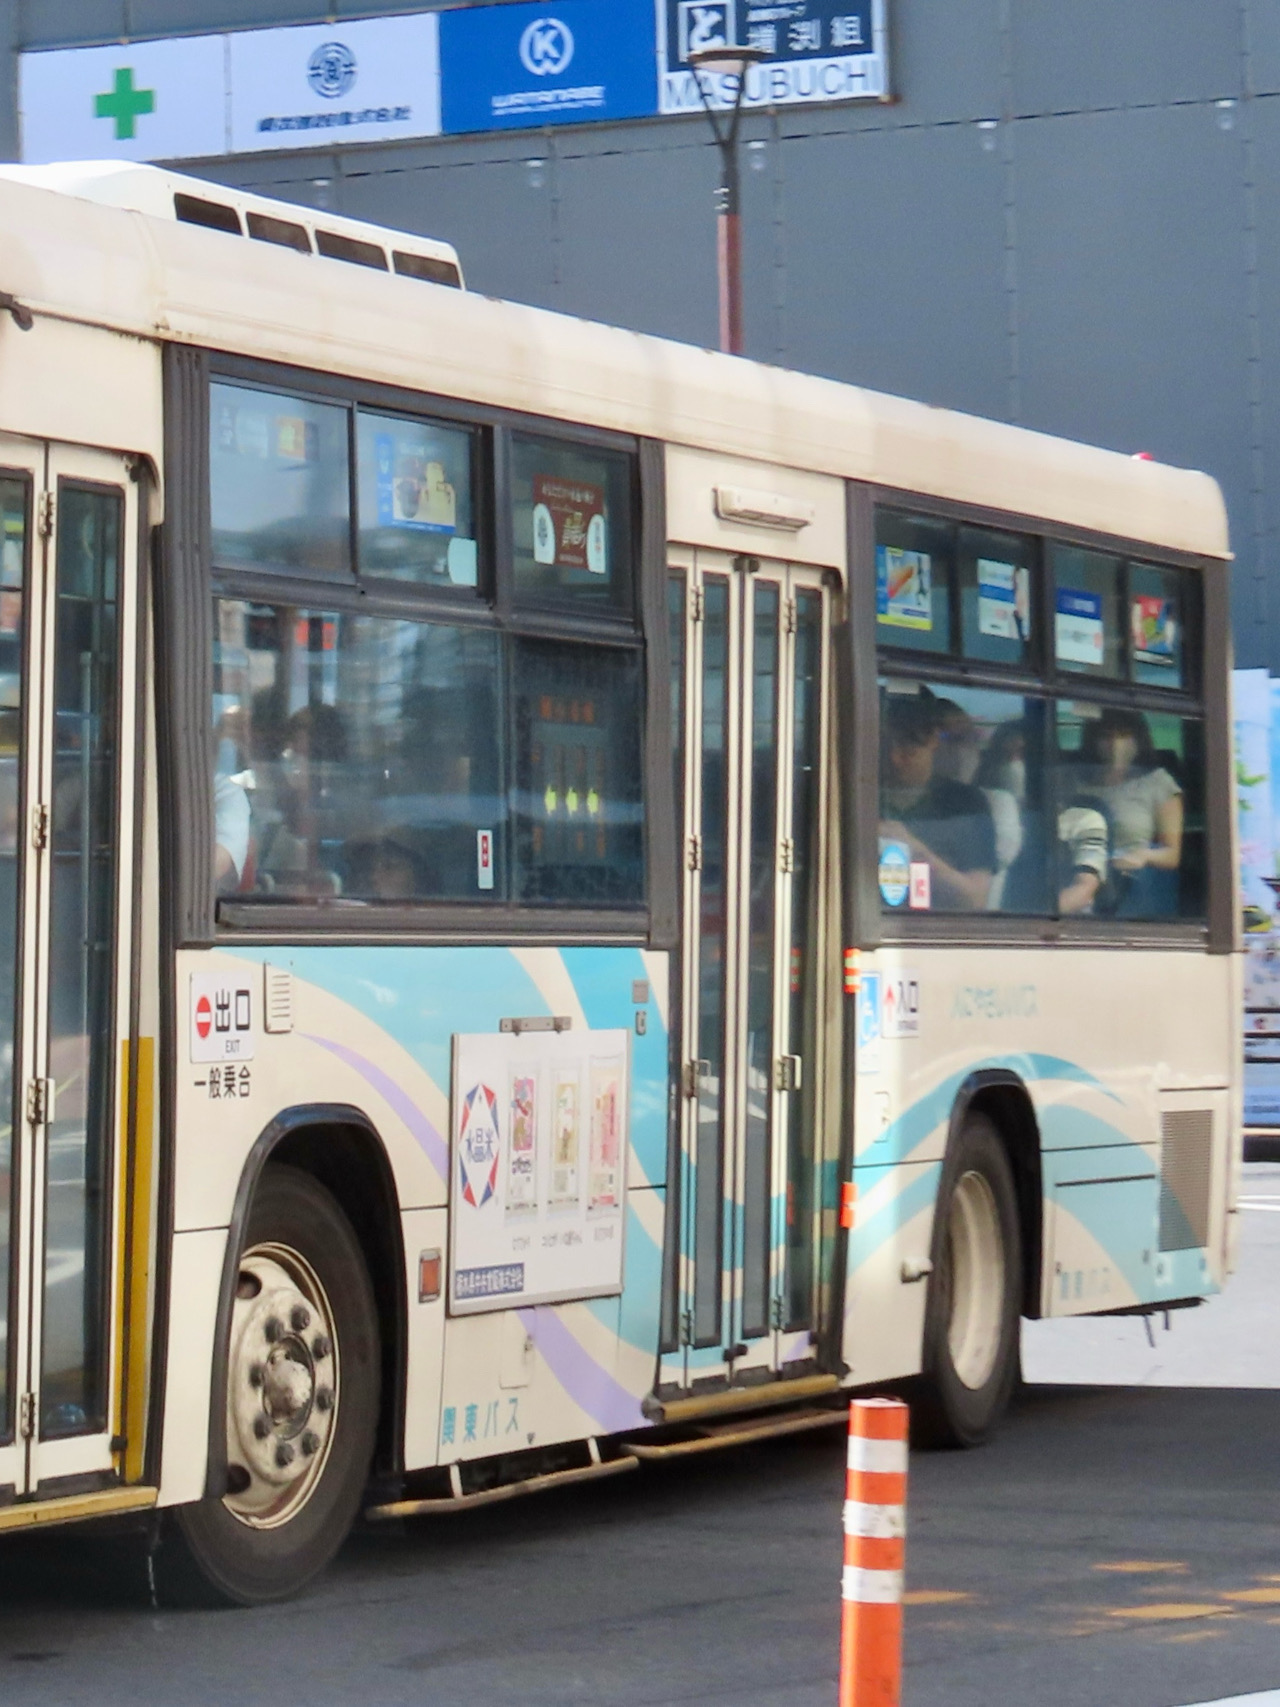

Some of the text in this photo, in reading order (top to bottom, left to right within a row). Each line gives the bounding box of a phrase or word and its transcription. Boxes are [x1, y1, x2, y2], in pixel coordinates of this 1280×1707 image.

[666, 59, 885, 107] MASUBUCHI
[215, 988, 251, 1032] 出口
[897, 980, 919, 1014] 入口
[225, 1039, 240, 1053] EXIT
[194, 1065, 251, 1099] 一般乗合
[465, 1127, 494, 1163] 水晶米
[440, 1397, 520, 1447] 関東バス
